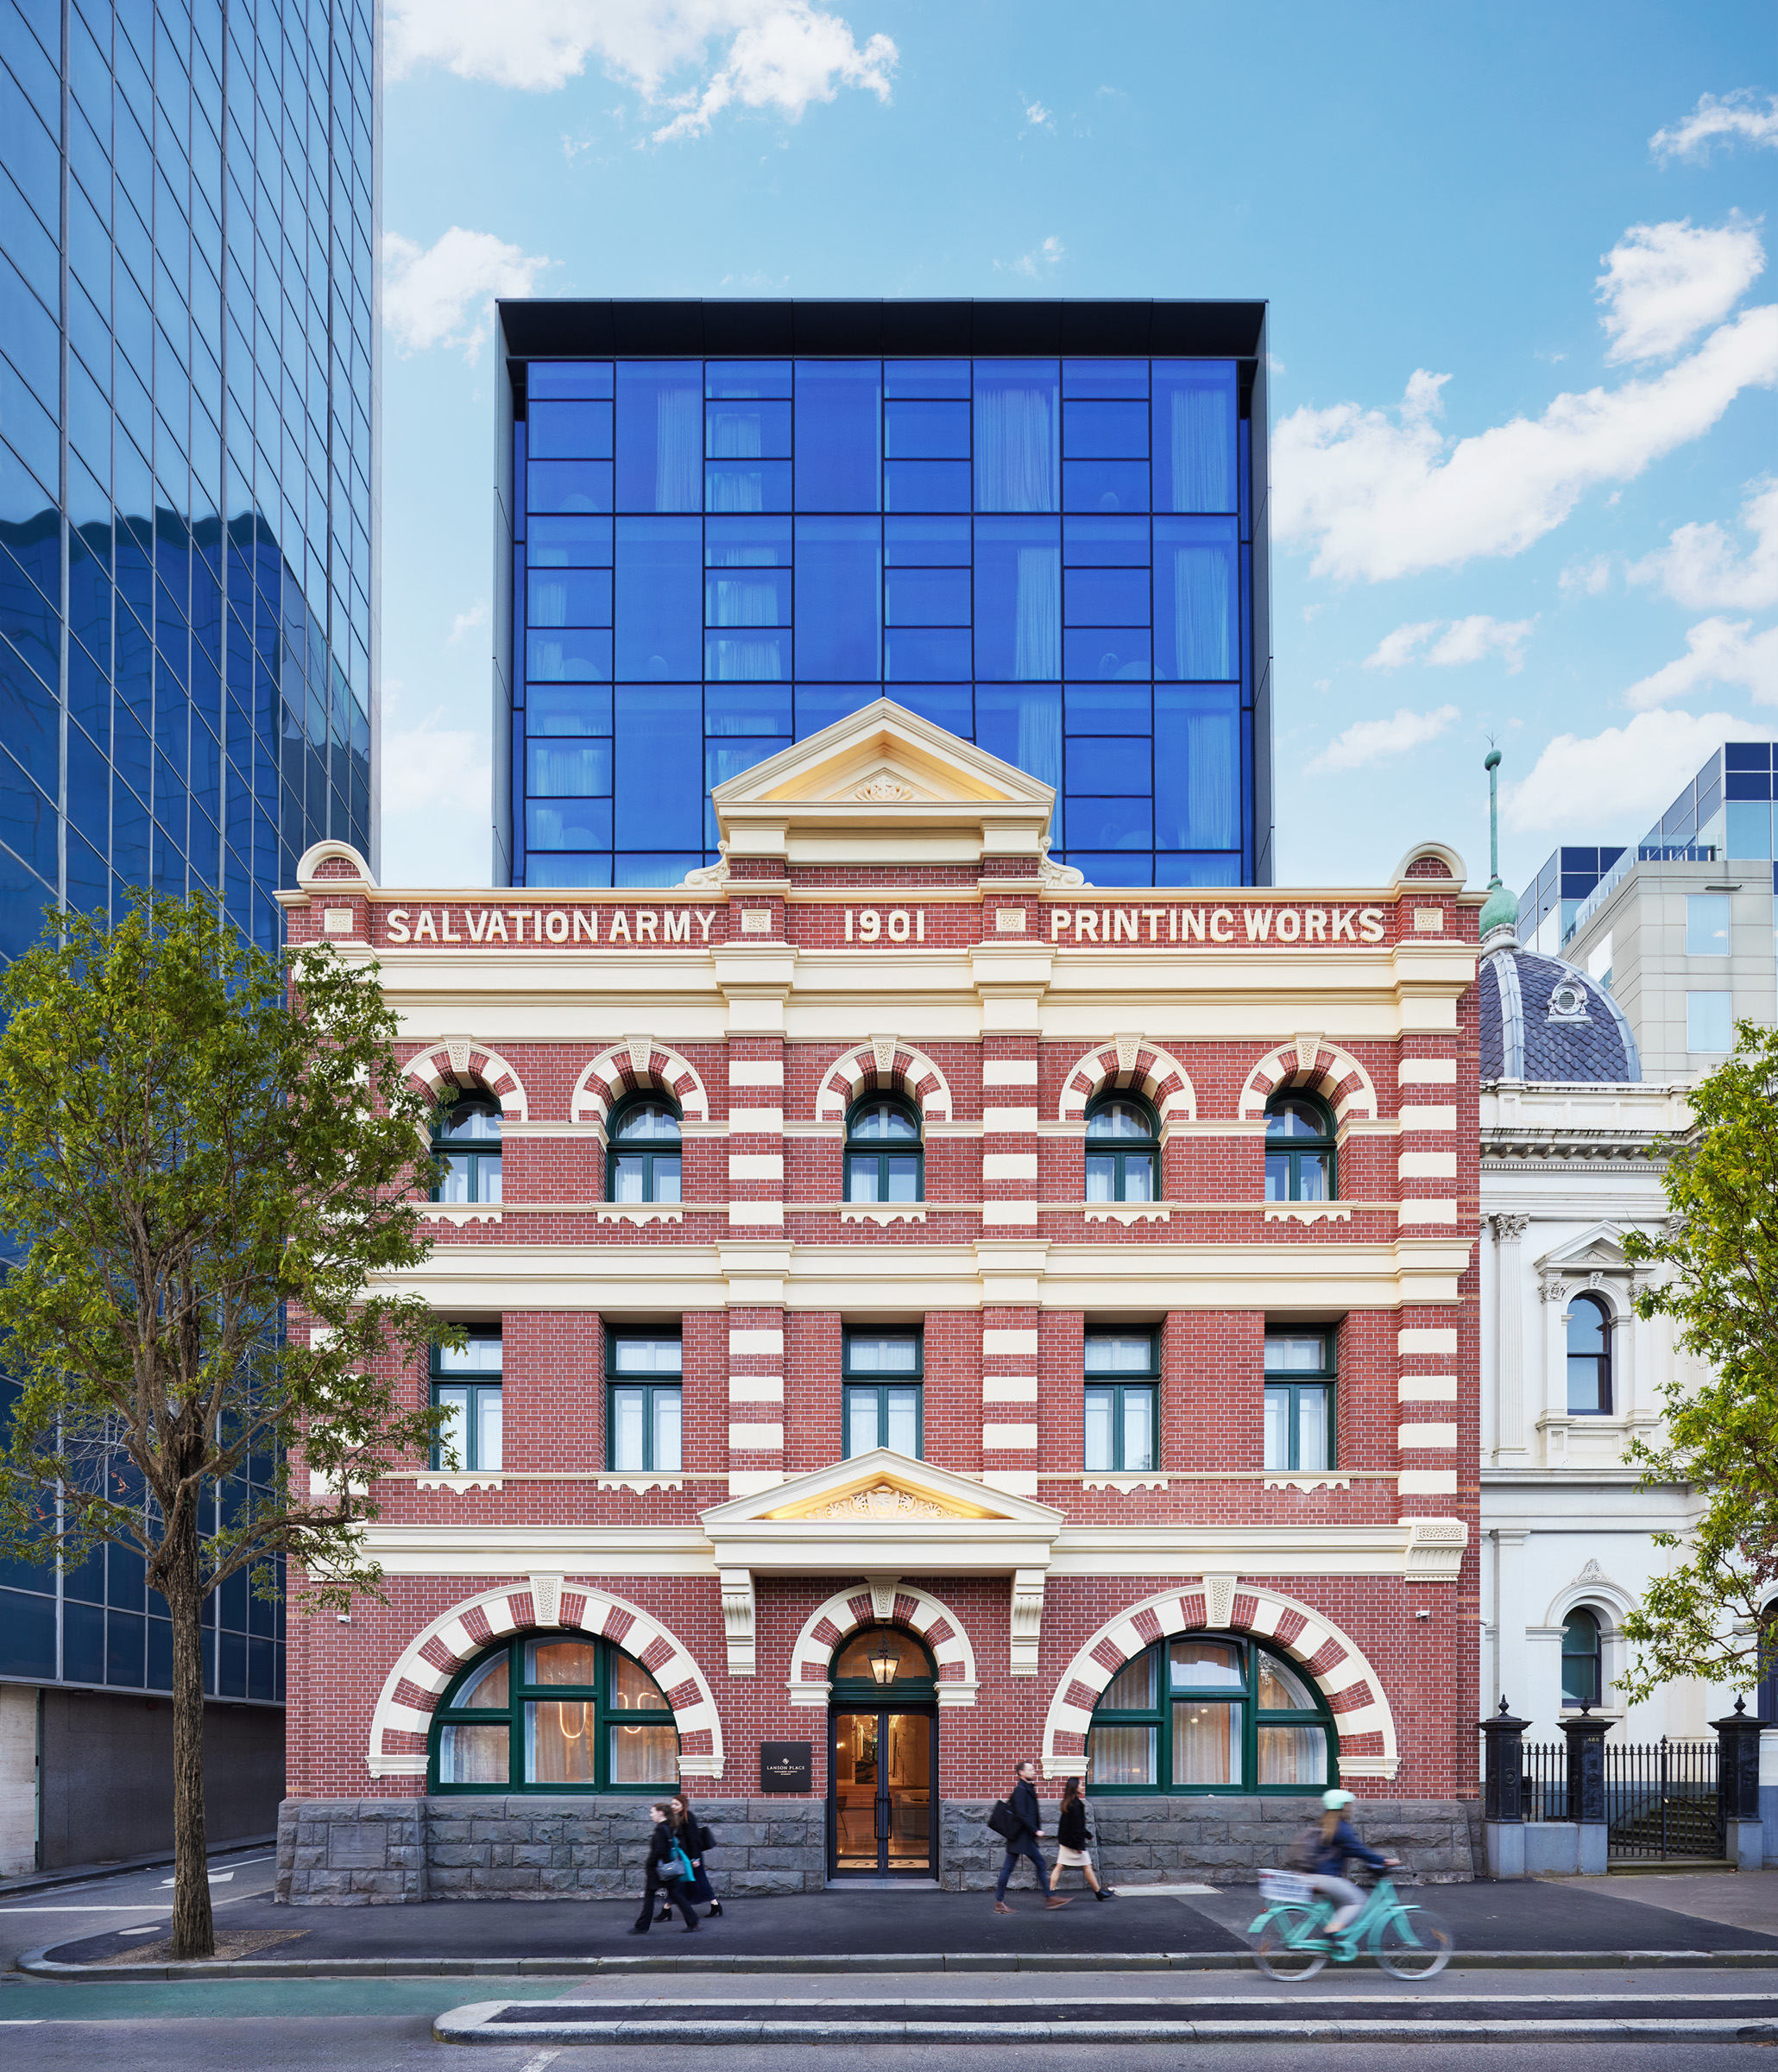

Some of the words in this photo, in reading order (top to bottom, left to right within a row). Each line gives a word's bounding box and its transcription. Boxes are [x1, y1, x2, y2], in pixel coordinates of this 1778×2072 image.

[387, 909, 598, 944] SALVATION
[608, 910, 716, 943] ARMY
[845, 910, 924, 942] 1901
[1243, 908, 1384, 943] WORKS
